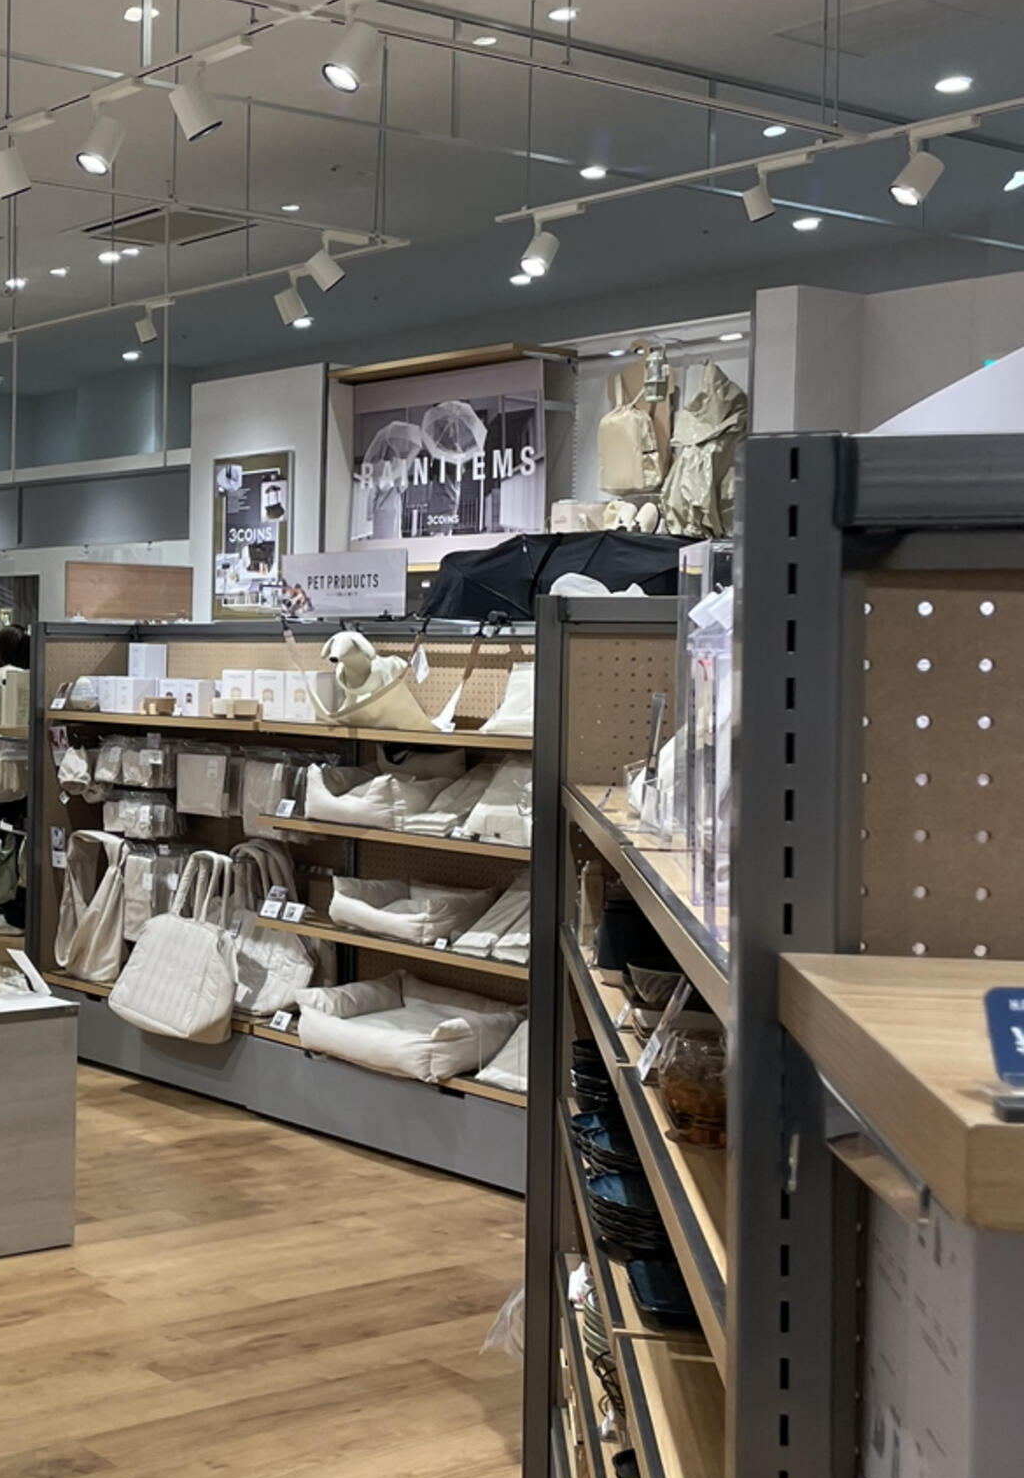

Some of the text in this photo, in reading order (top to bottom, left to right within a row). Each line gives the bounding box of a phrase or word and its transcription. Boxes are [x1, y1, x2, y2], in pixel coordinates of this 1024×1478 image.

[360, 446, 536, 490] RAIN ITEMS
[426, 514, 460, 526] 3COINS
[228, 526, 273, 543] 3COINS
[307, 573, 379, 590] PET PRODUCTS
